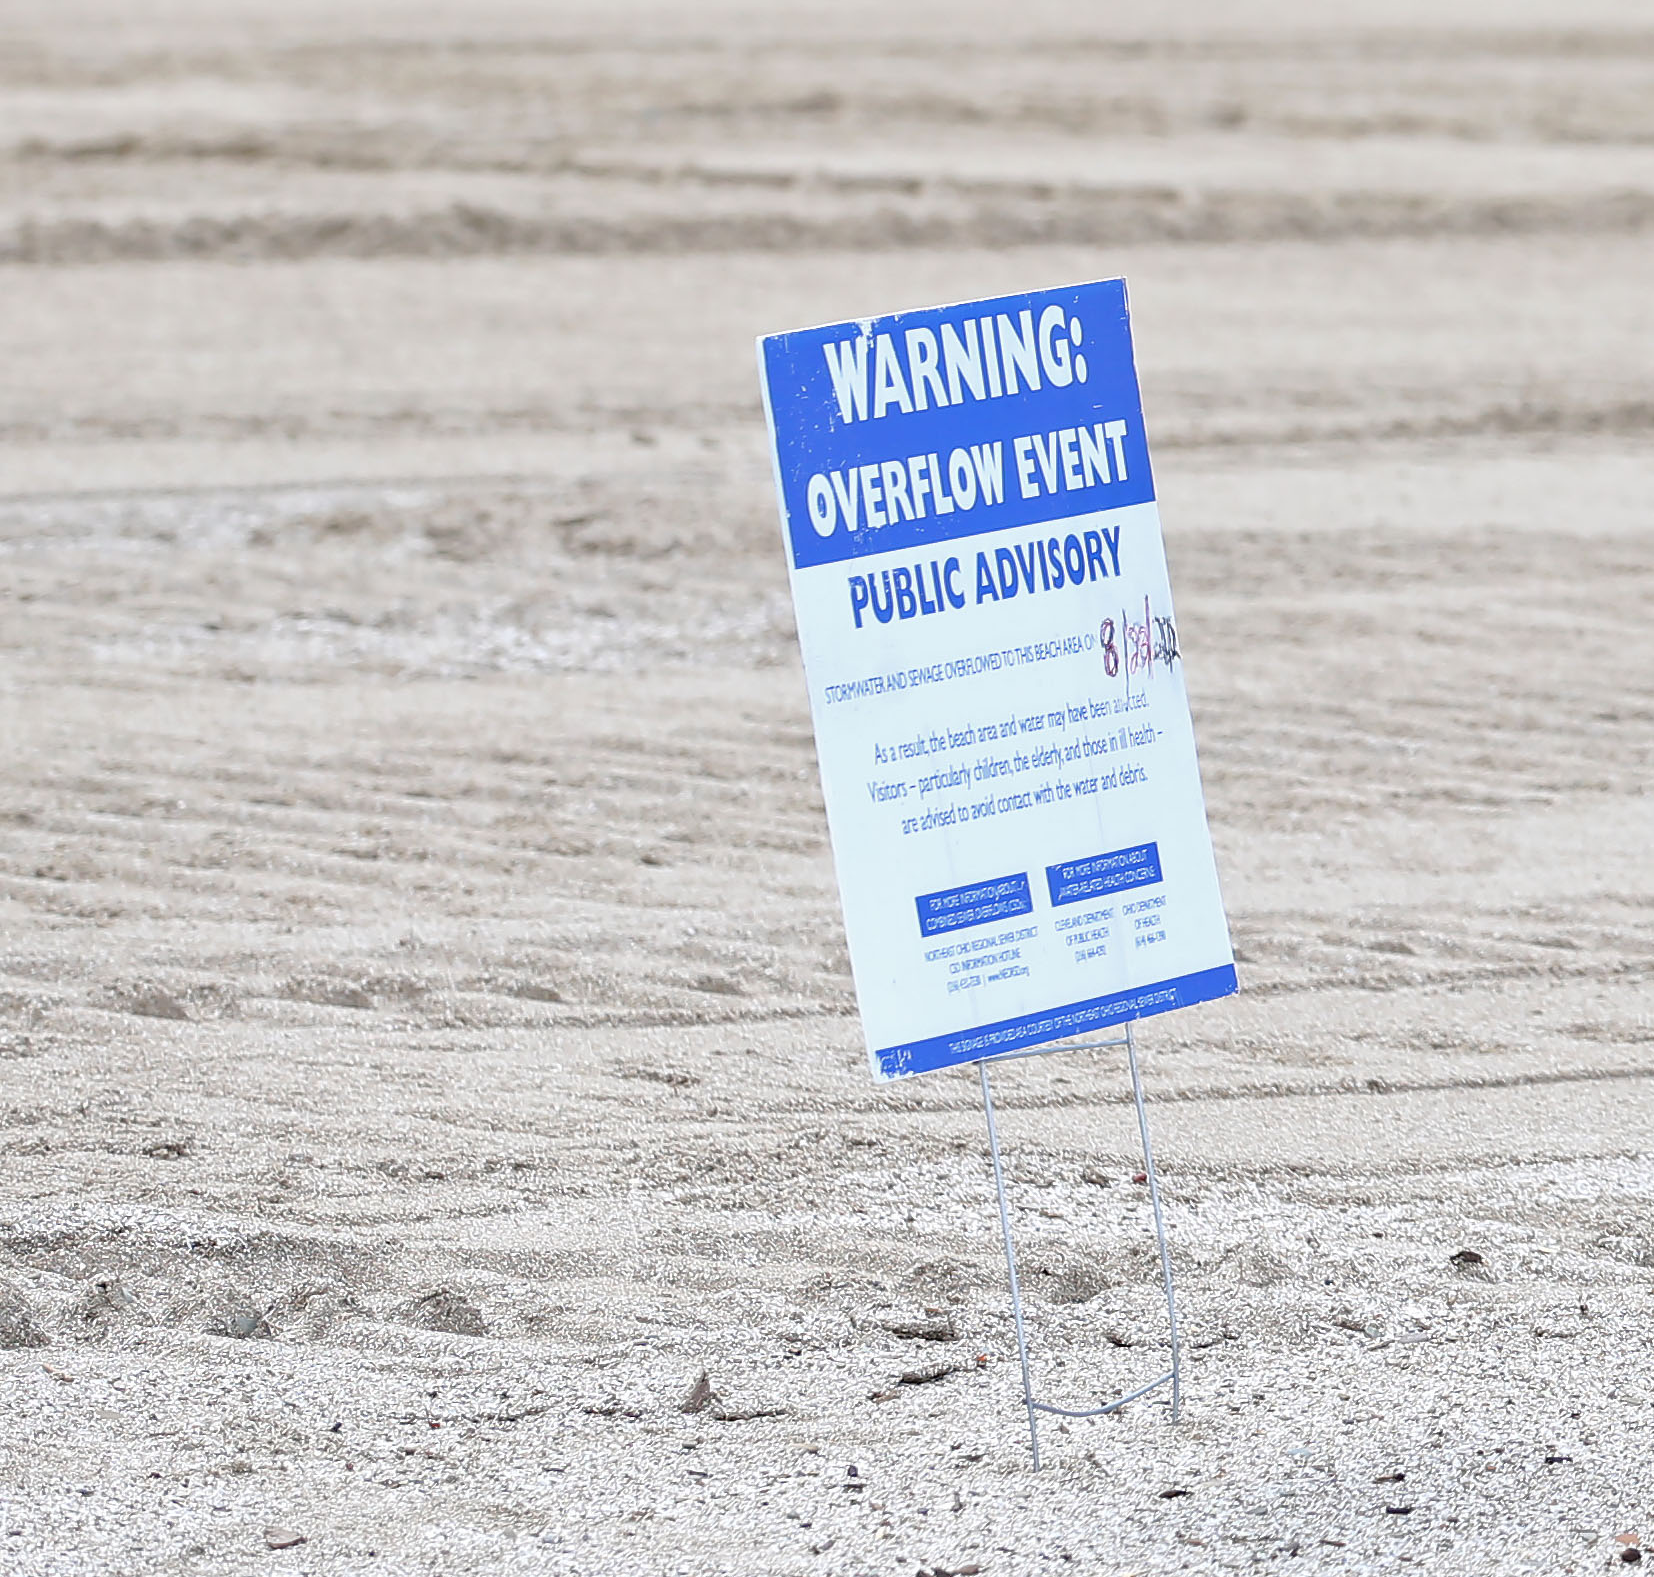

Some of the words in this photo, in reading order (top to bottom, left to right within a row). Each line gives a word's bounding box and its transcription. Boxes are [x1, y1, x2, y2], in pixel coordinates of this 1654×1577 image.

[823, 305, 1088, 424] WARNING:
[806, 441, 1005, 538] OVERFLOW
[1013, 420, 1128, 499] EVENT
[848, 556, 966, 629] PUBLIC
[976, 526, 1121, 604] ADVISORY
[825, 676, 885, 704] STORMWATER
[886, 671, 908, 692] AND
[908, 664, 944, 687] SEWAGE
[945, 653, 1002, 679] OVERFLOWED
[1002, 650, 1015, 667] TO
[1015, 646, 1034, 665] THIS
[1035, 640, 1063, 661] BEACH
[1062, 636, 1083, 655] AREA
[867, 776, 908, 804] Visitors
[917, 762, 973, 799] particularly
[972, 753, 1014, 782] children,
[1013, 749, 1030, 771] the
[1030, 742, 1066, 775] elderly,
[1064, 738, 1081, 761] and
[1082, 733, 1108, 757] those
[1108, 732, 1118, 751] in
[1128, 722, 1156, 747] health
[873, 742, 888, 765] As
[890, 747, 897, 761] a
[897, 733, 930, 761] result,
[929, 729, 947, 752] the
[947, 723, 976, 748] beach
[978, 725, 998, 742] area
[998, 714, 1017, 737] and
[1019, 715, 1046, 733] water
[1048, 710, 1068, 734] may
[1067, 700, 1088, 723] have
[1089, 695, 1112, 718] been
[902, 817, 919, 834] are
[919, 803, 957, 830] advised
[958, 806, 969, 822] to
[970, 794, 997, 819] avoid
[997, 792, 1032, 813] contact
[1033, 782, 1055, 805] with
[1055, 778, 1072, 800] the
[1074, 778, 1100, 796] water
[1100, 768, 1117, 790] and
[1118, 761, 1148, 786] debris.
